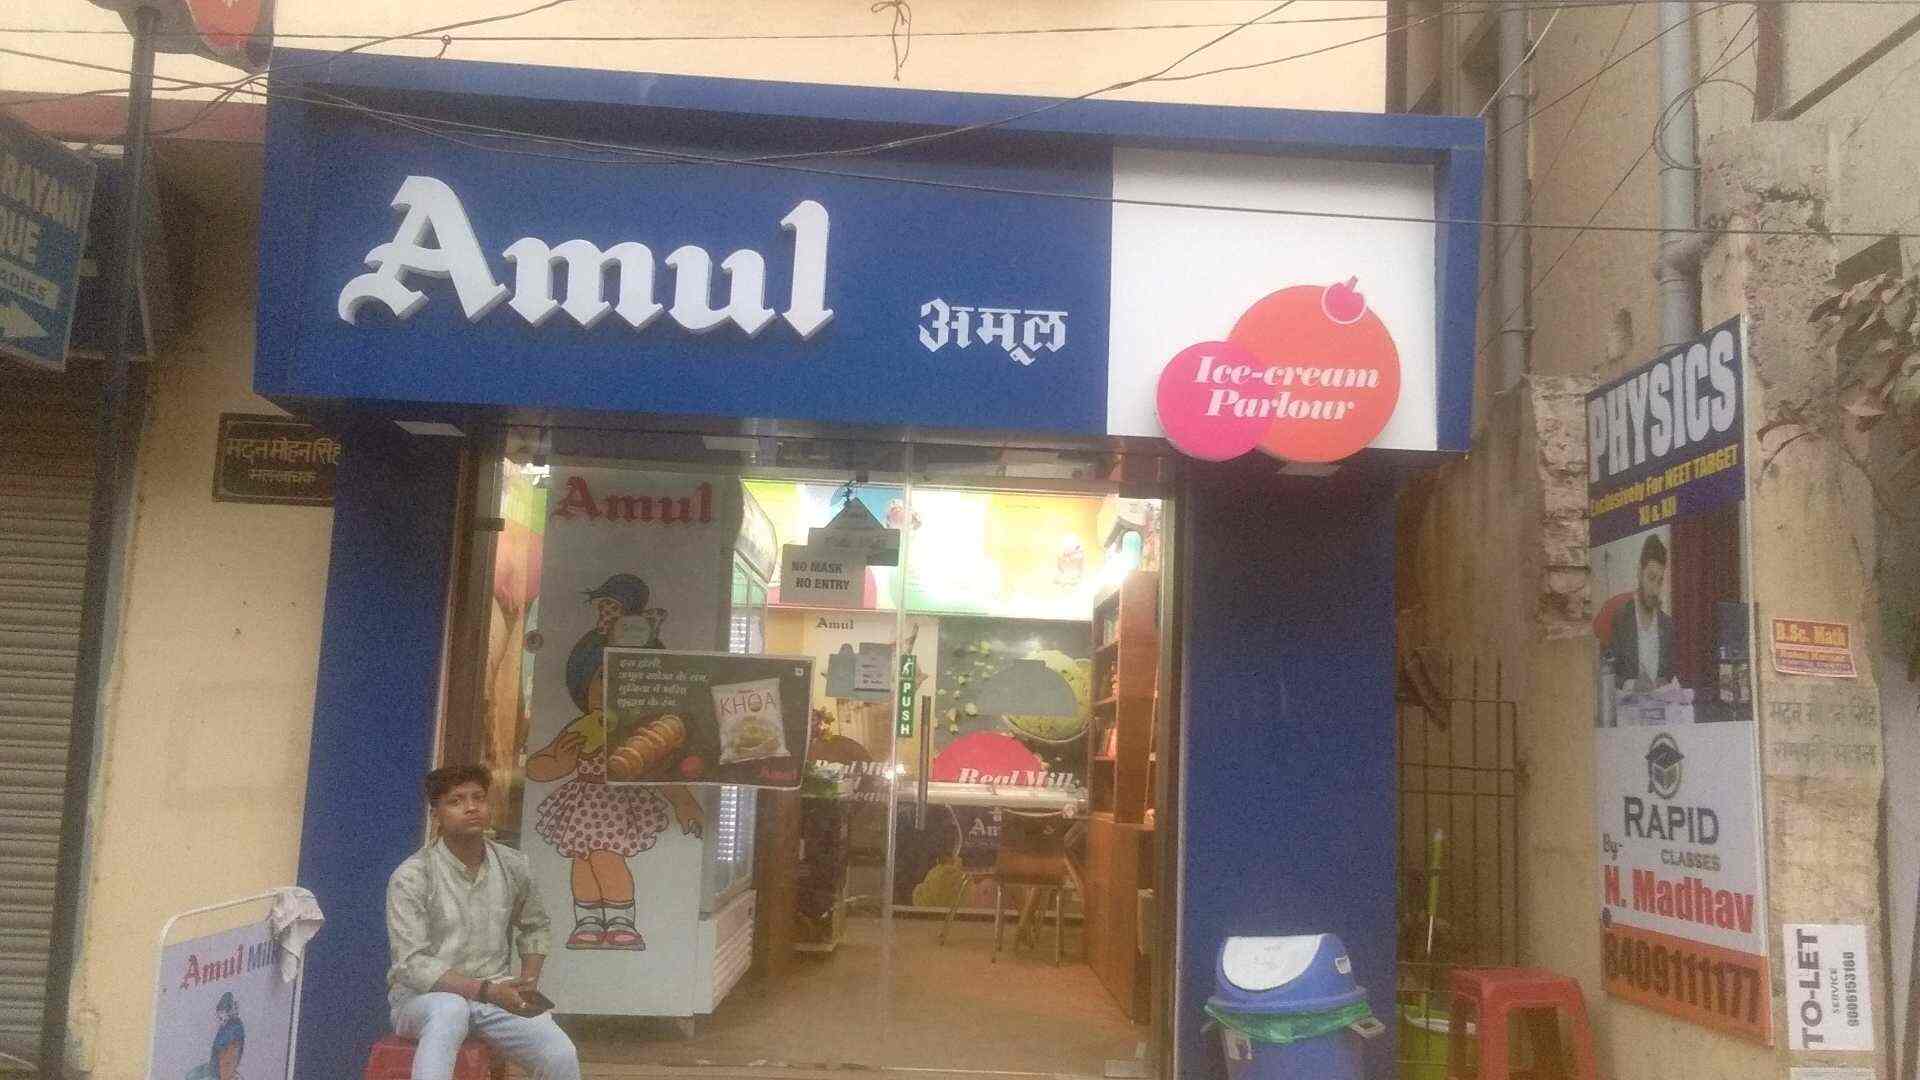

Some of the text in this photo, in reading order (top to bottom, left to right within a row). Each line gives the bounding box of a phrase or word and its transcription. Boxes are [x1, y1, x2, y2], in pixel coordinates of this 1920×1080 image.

[337, 174, 834, 339] Amul
[917, 298, 1069, 366] अमूल
[1193, 356, 1380, 388] Ice-cream
[1205, 389, 1356, 419] Parlour
[1588, 329, 1737, 483] PHYSICS
[553, 475, 713, 524] Amul
[791, 560, 843, 575] NO MASK
[796, 577, 851, 591] NO ENTRY
[815, 616, 856, 631] Amul
[718, 691, 778, 717] KHOA
[900, 682, 913, 735] PUSH
[958, 767, 1019, 786] Real
[1623, 796, 1720, 845] RAPID
[1660, 849, 1721, 872] CLASSES
[1632, 868, 1754, 933] Madhav
[180, 943, 244, 990] Amul
[1796, 928, 1824, 1049] TO-LET
